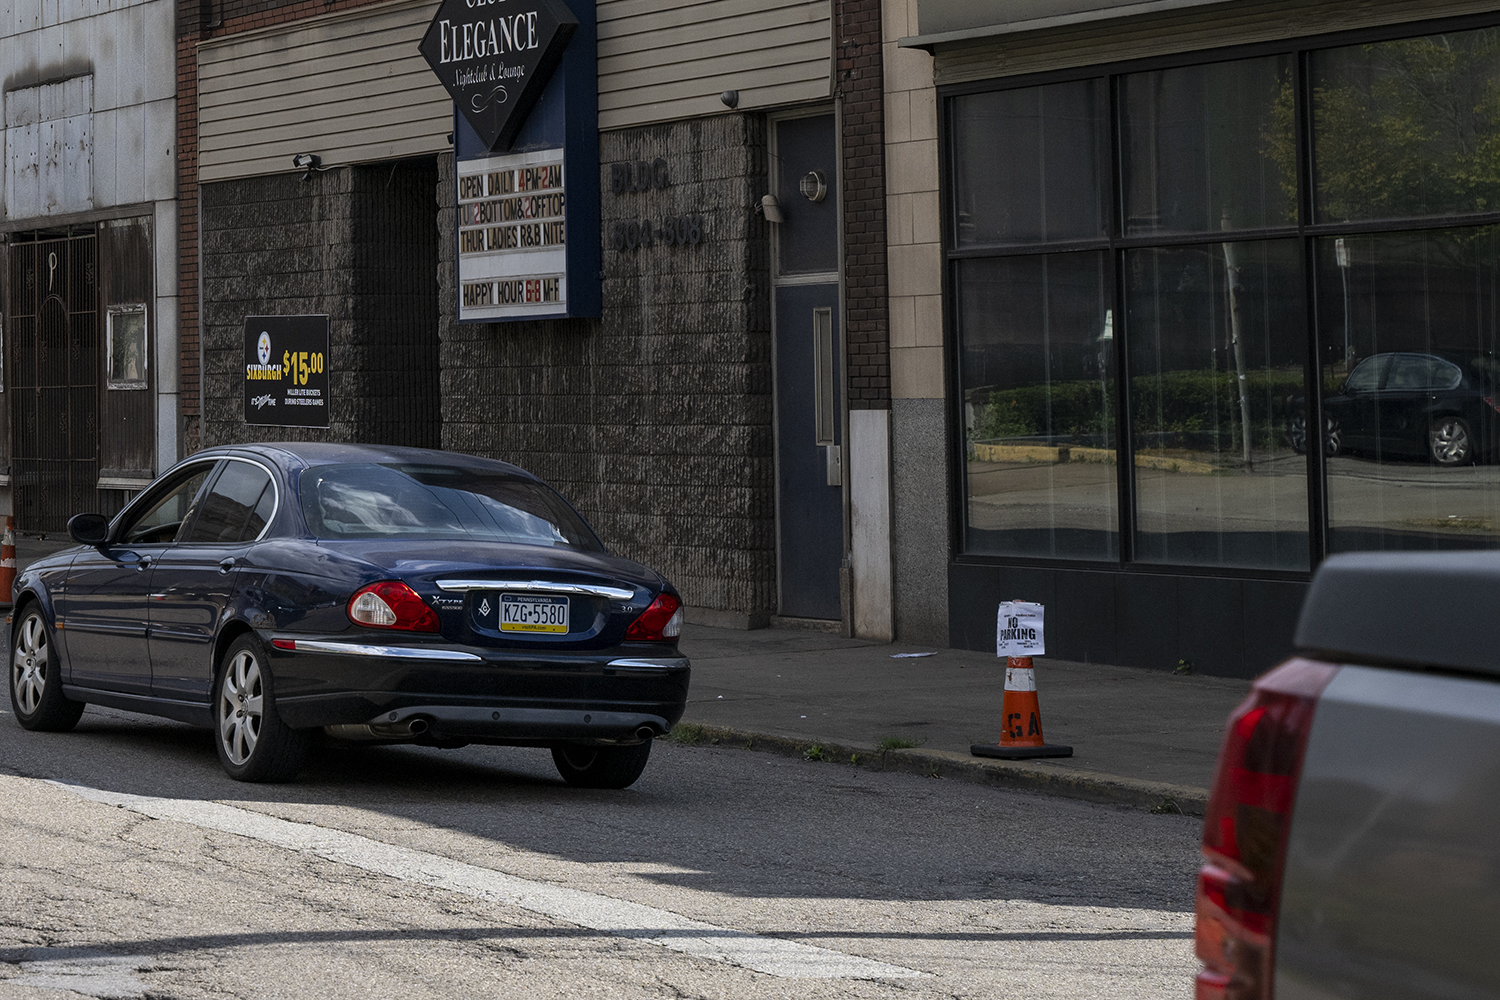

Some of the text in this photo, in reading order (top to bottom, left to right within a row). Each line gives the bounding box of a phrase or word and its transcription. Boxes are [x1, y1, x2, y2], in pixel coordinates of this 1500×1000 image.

[452, 64, 488, 91] Nightclub
[498, 61, 526, 83] Lounge
[459, 165, 562, 199] OPEN DAILY 4PM-2AM
[460, 222, 565, 253] THUR LADIES R&B NITE
[463, 278, 560, 306] HAPPY HOUR 6-8 M-F
[246, 364, 282, 380] SIXBURGH
[283, 350, 324, 385] $15.00
[1000, 628, 1036, 641] PARKING
[1007, 616, 1018, 629] NO
[1008, 711, 1040, 738] GA
